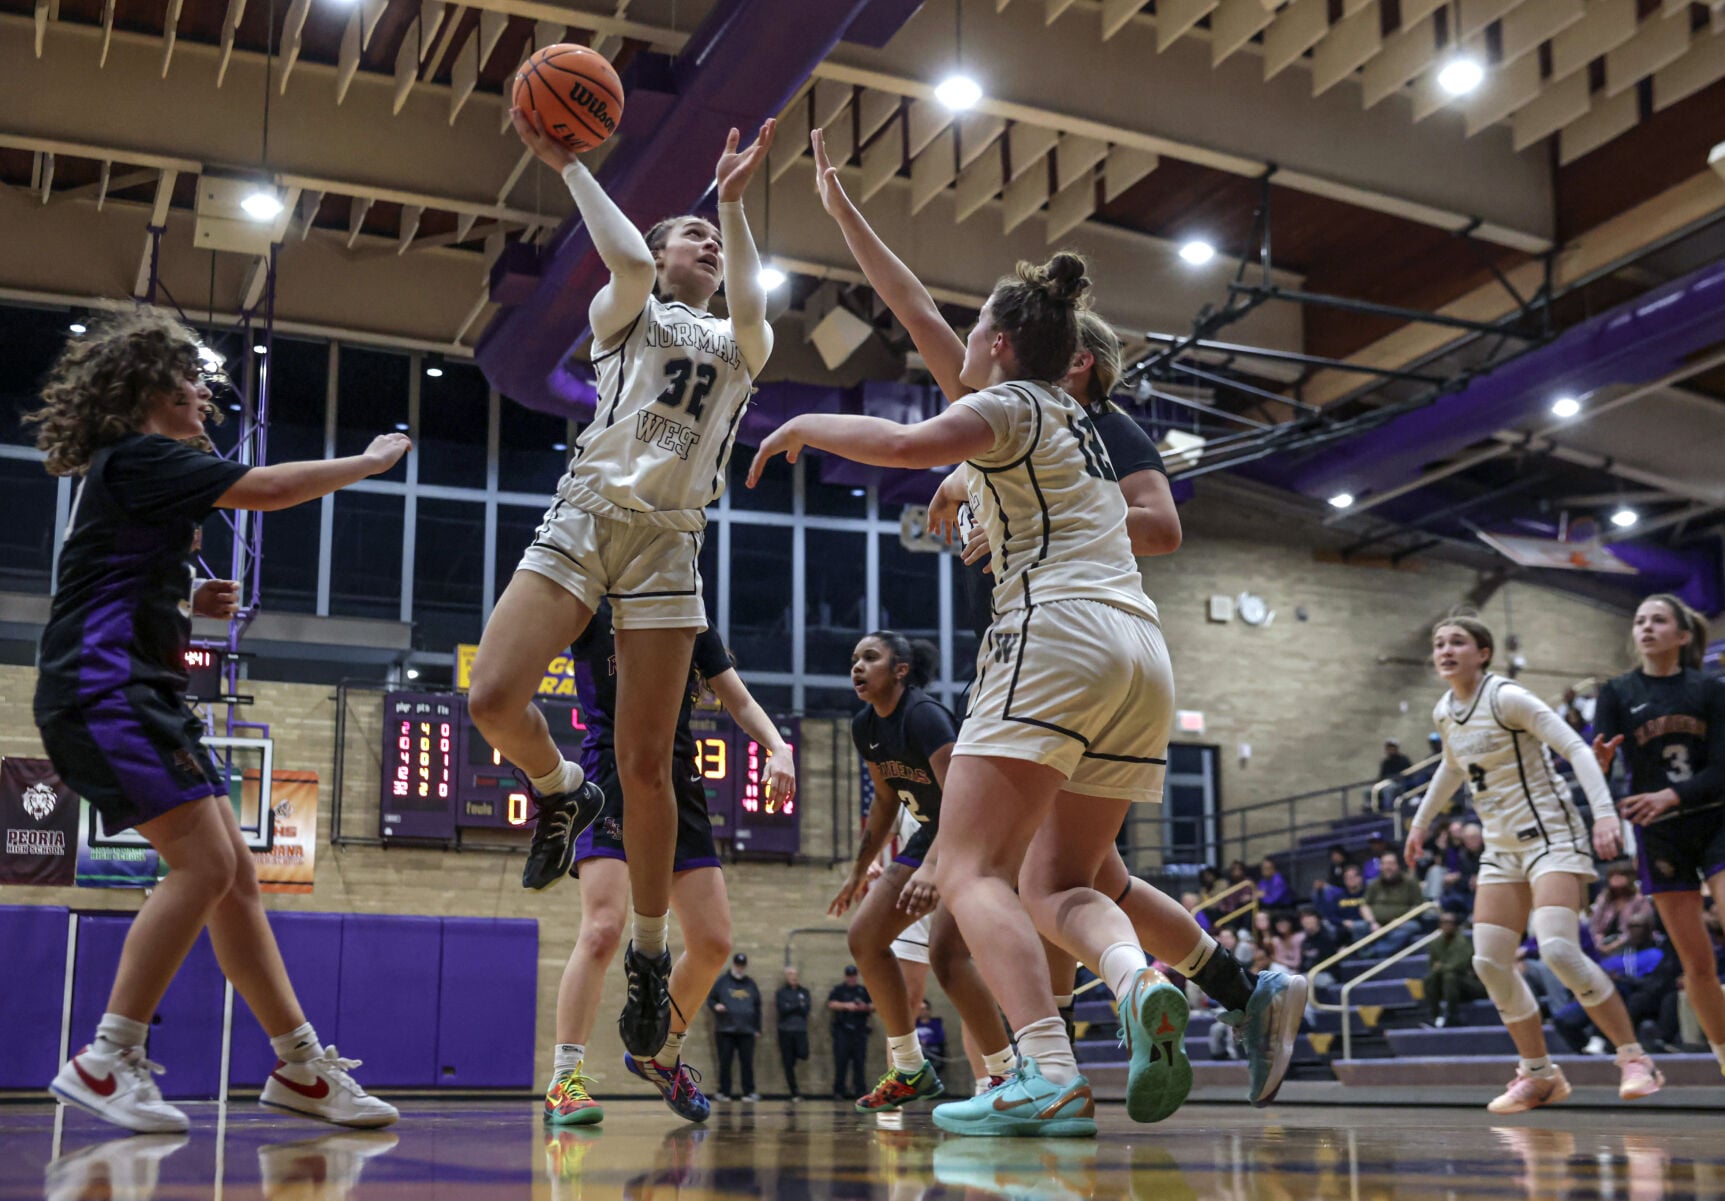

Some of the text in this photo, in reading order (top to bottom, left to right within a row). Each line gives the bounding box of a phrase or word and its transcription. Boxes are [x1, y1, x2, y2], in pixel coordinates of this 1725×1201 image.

[569, 82, 616, 132] Wilson
[646, 320, 740, 370] NORMAL
[656, 359, 717, 422] 32
[636, 409, 700, 460] WEST
[994, 632, 1020, 663] W
[419, 737, 430, 751] 0
[440, 738, 450, 752] 0
[420, 722, 430, 735] 4
[440, 723, 450, 737] 0
[400, 751, 449, 766] 4 0 1
[1662, 744, 1693, 783] 3
[418, 782, 429, 797] 2
[438, 783, 448, 797] 0
[419, 767, 429, 781] 4
[443, 769, 449, 782] 1
[508, 793, 528, 825] 0
[897, 790, 930, 822] 2
[7, 829, 65, 847] PEORIA
